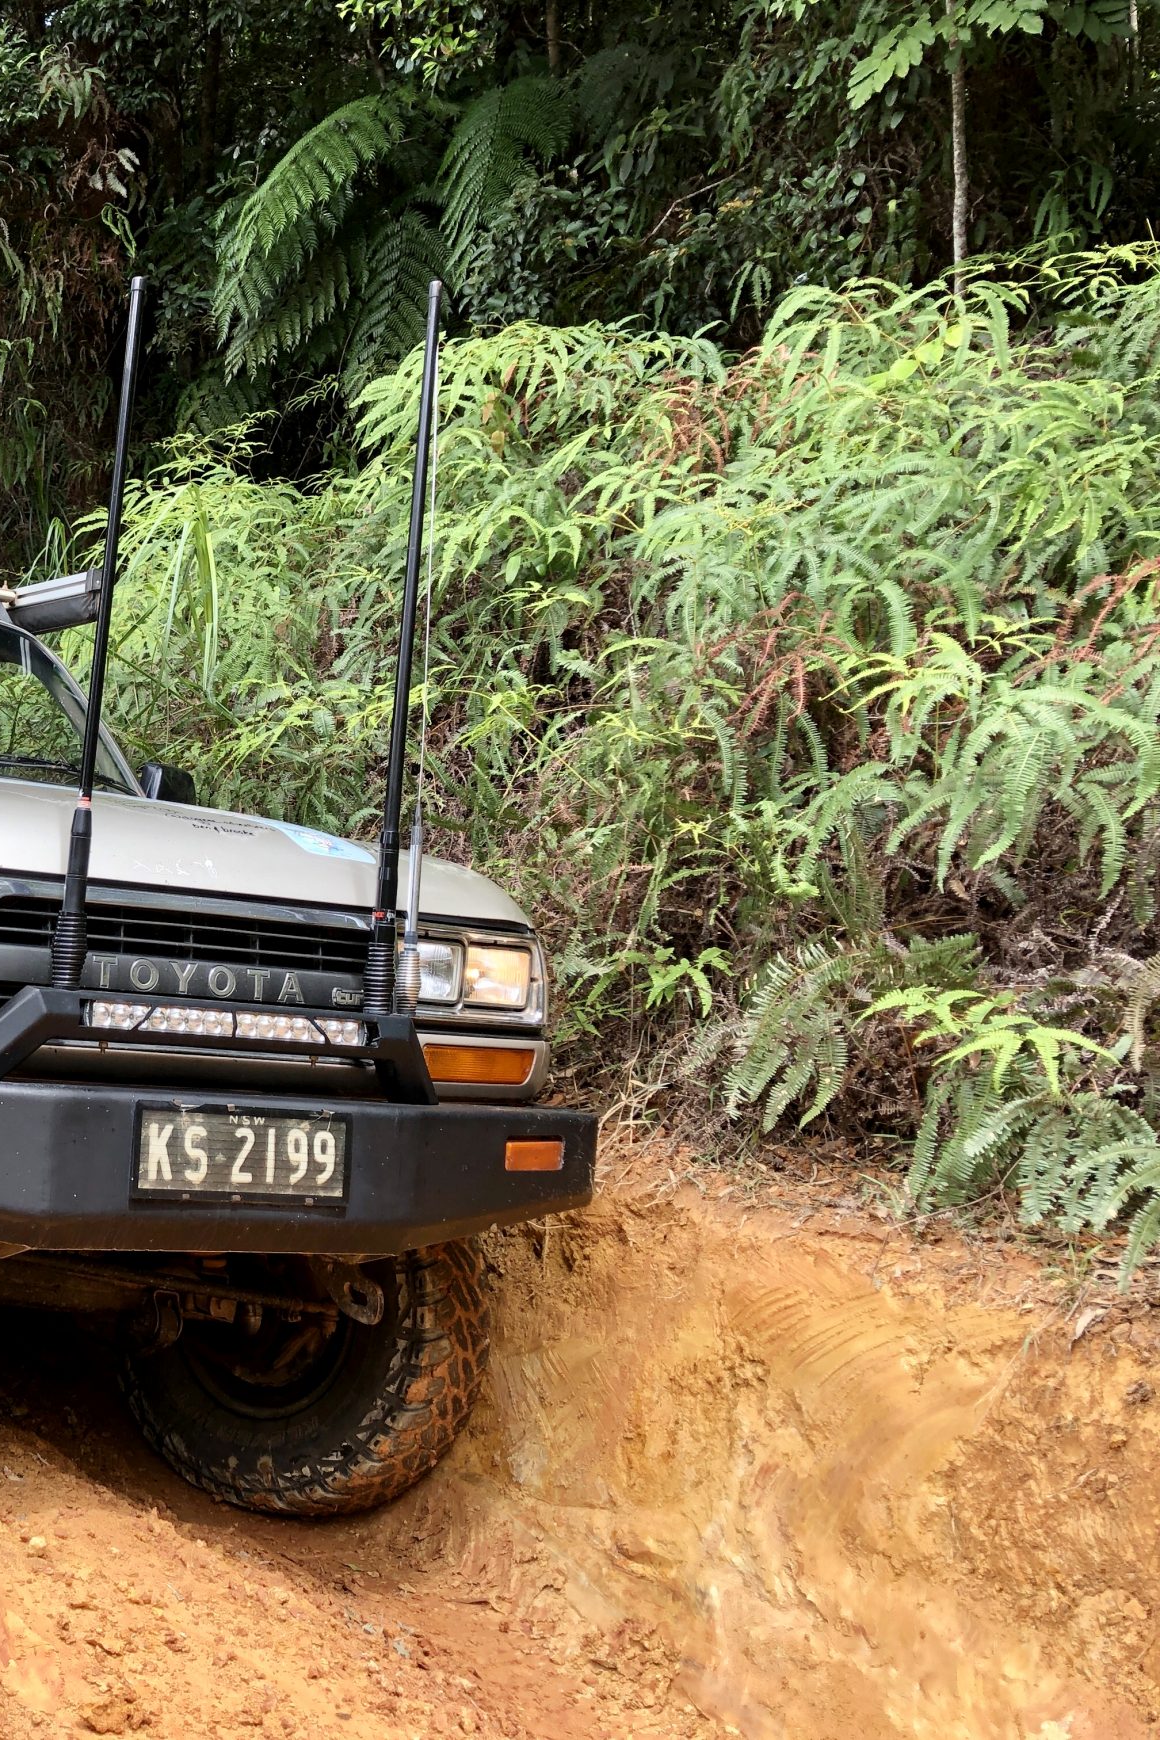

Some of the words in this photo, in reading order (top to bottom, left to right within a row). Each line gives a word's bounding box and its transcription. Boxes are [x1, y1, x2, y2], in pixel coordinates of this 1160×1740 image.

[92, 955, 305, 1005] TOYOTA
[336, 989, 364, 1006] tur
[229, 1114, 266, 1126] NSW
[146, 1122, 209, 1185] KS
[230, 1127, 336, 1186] 2199
